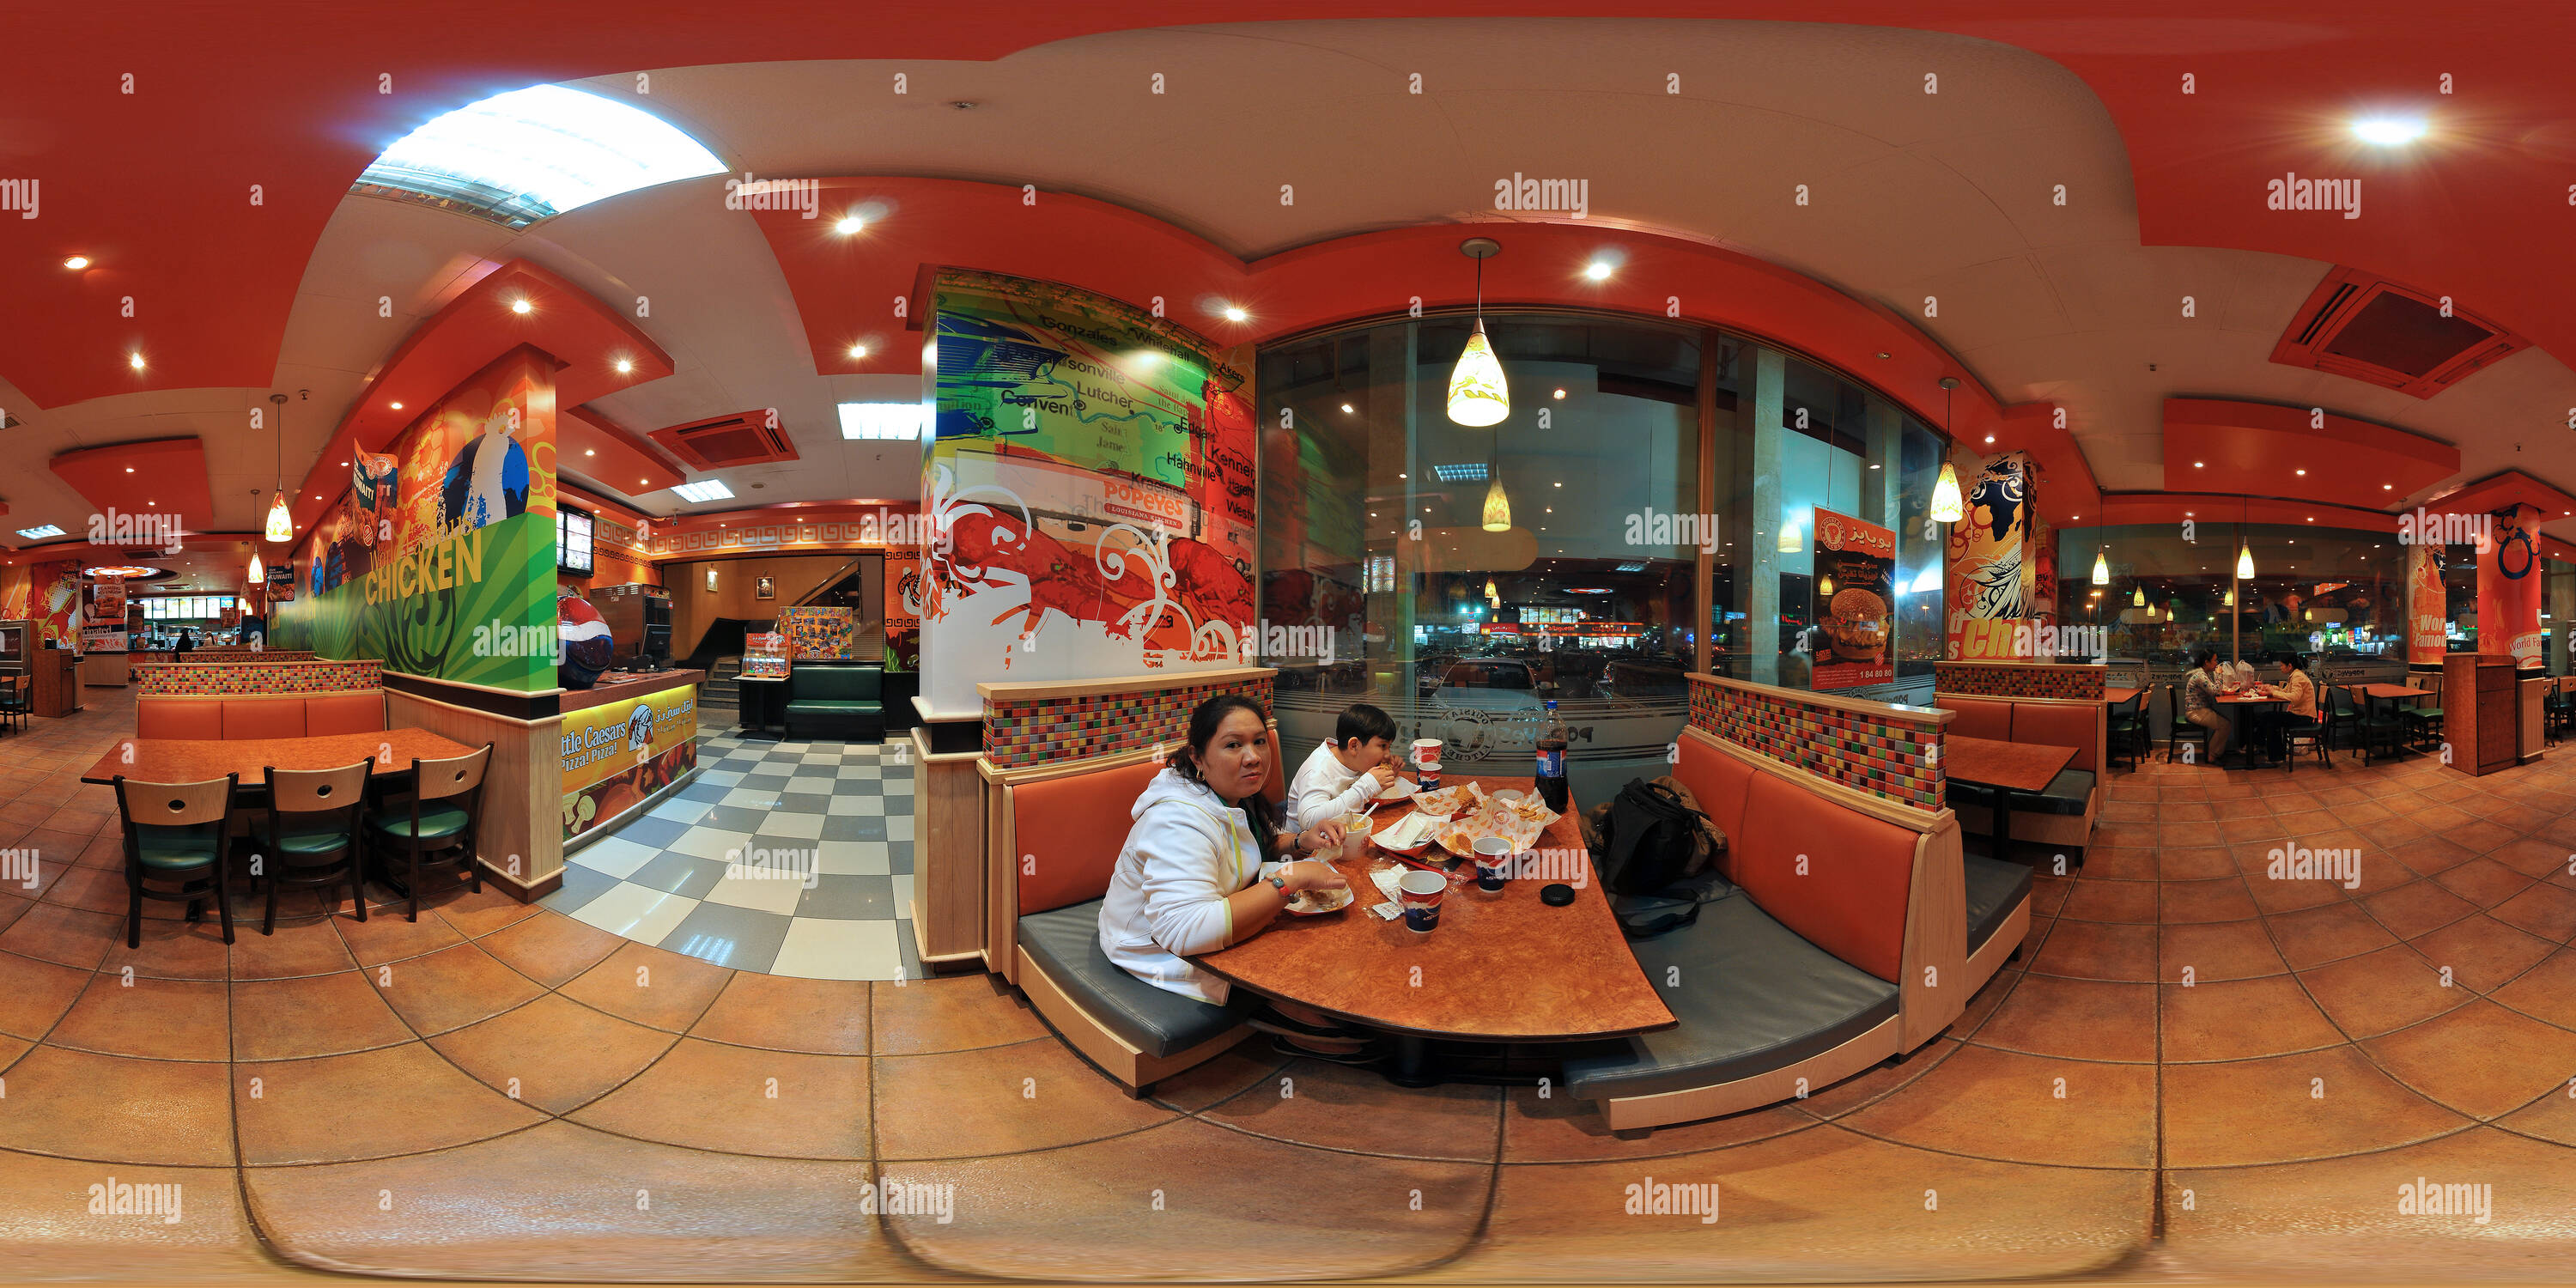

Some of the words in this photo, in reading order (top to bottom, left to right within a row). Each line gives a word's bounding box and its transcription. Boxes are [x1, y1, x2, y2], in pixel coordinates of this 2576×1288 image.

[1041, 315, 1118, 346] Gonzales
[1133, 327, 1191, 362] Whitehall
[1219, 362, 1245, 384] Akers
[1076, 380, 1134, 410] Lutcher
[1167, 452, 1216, 482] Hahnville
[1111, 506, 1149, 520] LOUISIANA
[1150, 514, 1177, 526] KITCHEN
[1821, 517, 1845, 535] LOUISIANA
[1822, 536, 1845, 550] KITCHEN
[1849, 526, 1892, 552] بوبايز
[366, 529, 482, 606] CHICKEN
[2509, 637, 2530, 651] World
[1865, 670, 1874, 678] 84
[584, 721, 627, 751] Caesars
[591, 741, 617, 764] Pizza!
